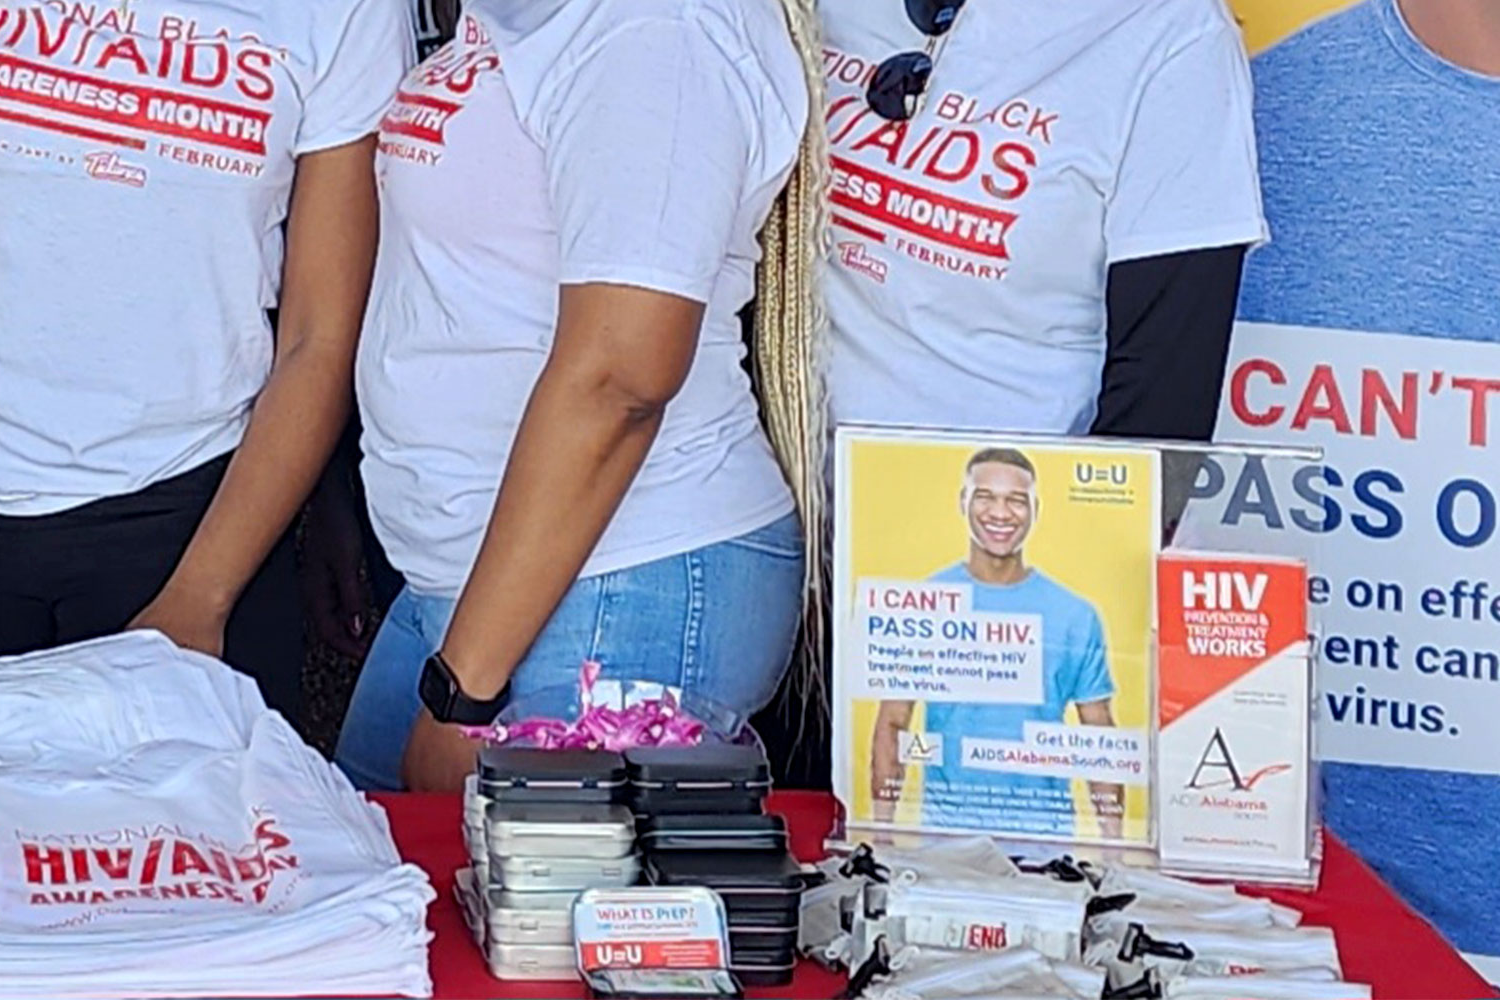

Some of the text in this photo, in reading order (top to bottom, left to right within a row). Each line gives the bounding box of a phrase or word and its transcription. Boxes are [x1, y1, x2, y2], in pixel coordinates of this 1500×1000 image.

[147, 97, 264, 142] MONTH
[157, 142, 265, 177] FEBRUARY
[885, 190, 1005, 246] MONTH
[894, 237, 1010, 281] FEBRUARY
[1076, 462, 1128, 486] U=U
[868, 588, 961, 614] I CAN'T
[1181, 570, 1269, 611] HIV
[1346, 578, 1404, 613] on
[868, 615, 1036, 646] PASS ON HIV.
[1183, 611, 1259, 626] PREVENTION
[1185, 624, 1268, 639] TREATMENT
[868, 643, 914, 662] People
[937, 648, 998, 663] effective
[1001, 651, 1027, 665] HIV
[1187, 637, 1267, 659] WORKS
[867, 660, 1019, 682] treatment cannot pass
[888, 676, 911, 690] the
[913, 678, 951, 693] virus.
[1327, 686, 1460, 737] virus.
[1035, 731, 1139, 752] Get the facts
[970, 746, 1142, 774] AIDSAlabamaSouth.org
[22, 819, 291, 886] HIV/AIDS
[596, 908, 640, 920] WHAT
[640, 908, 654, 920] IS
[969, 923, 1008, 952] END
[595, 944, 643, 966] U=U
